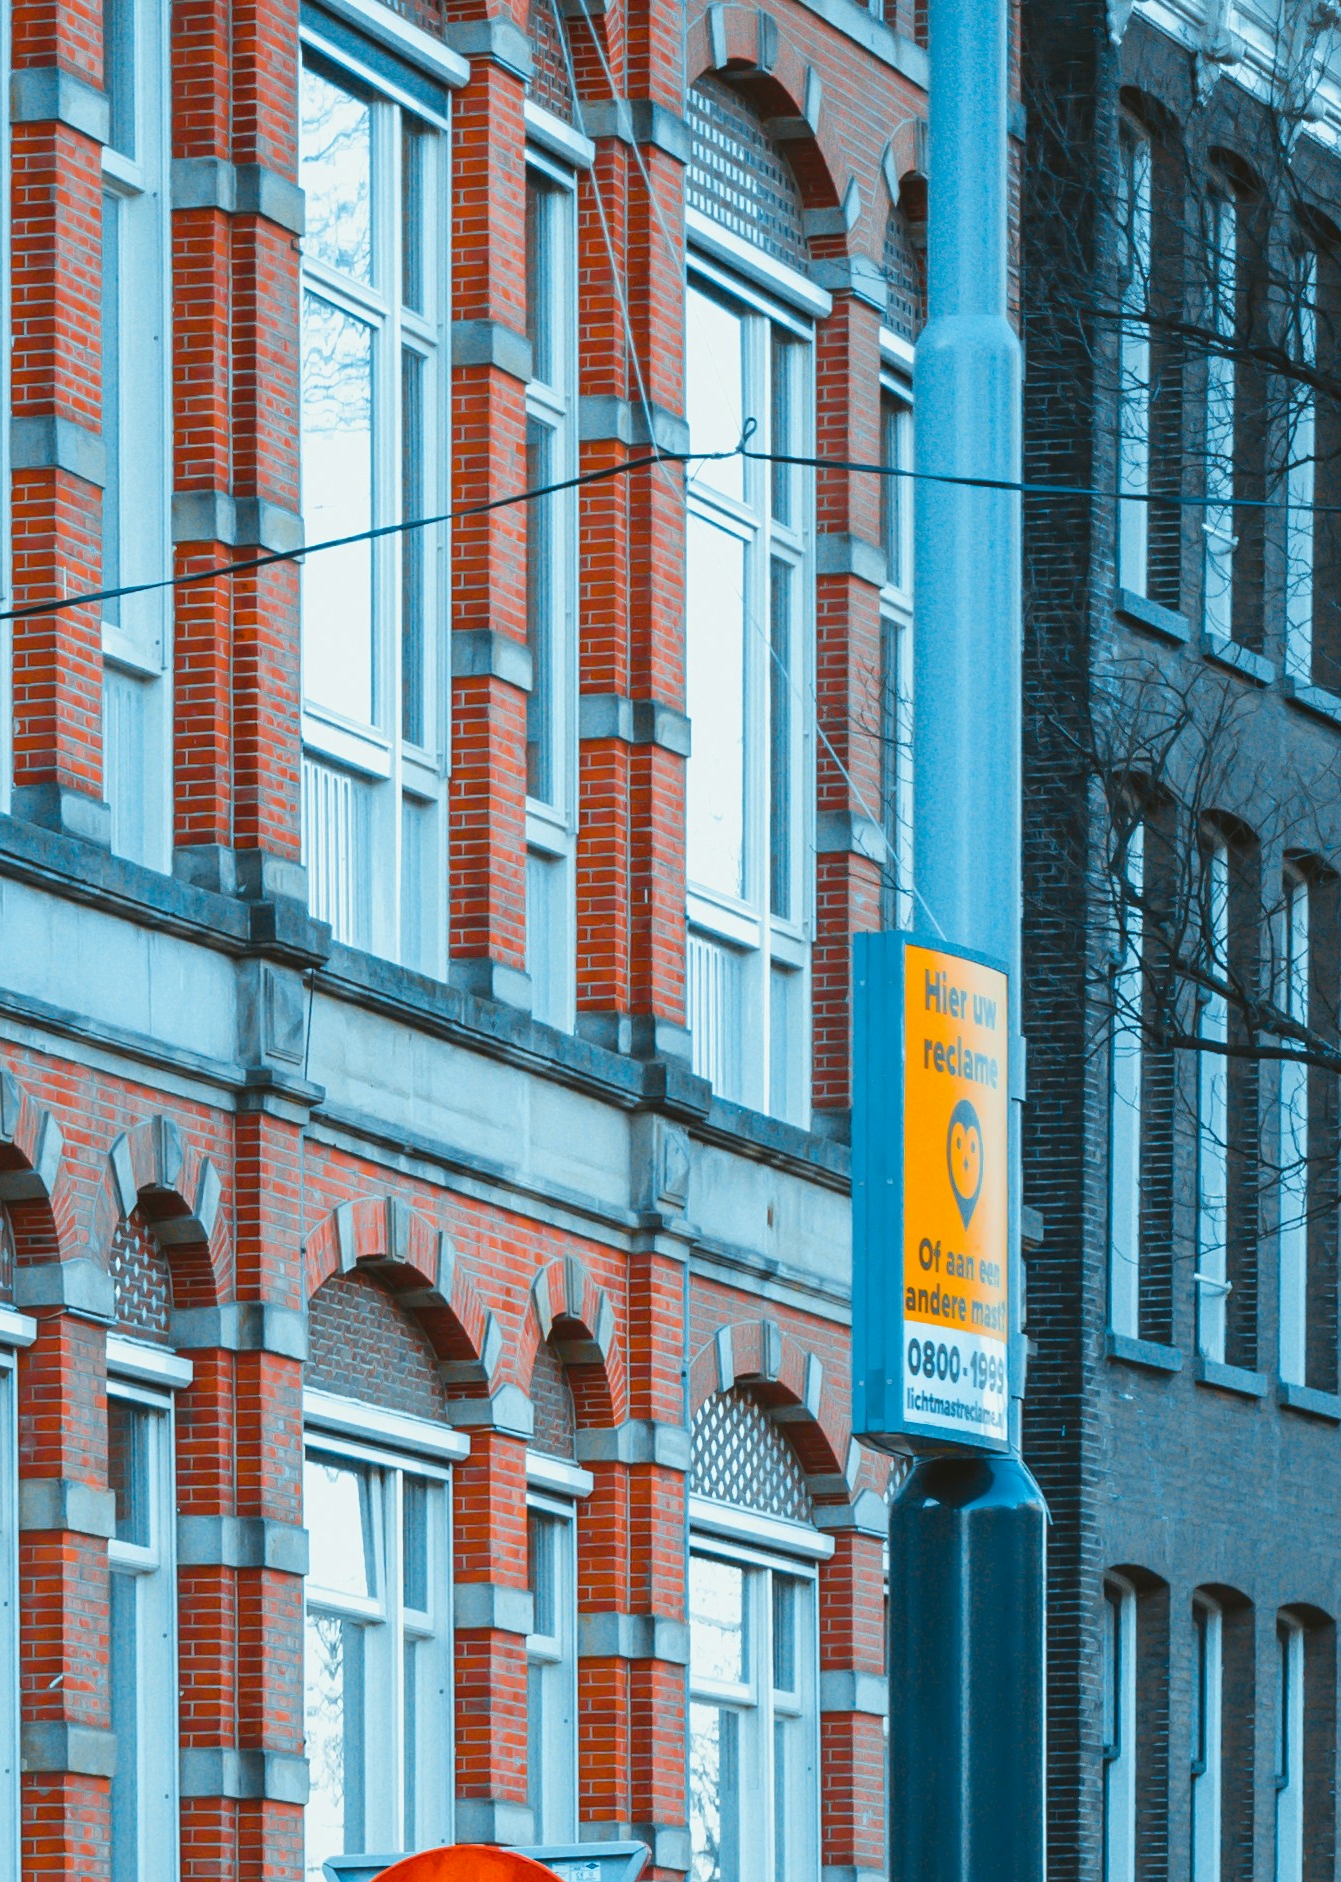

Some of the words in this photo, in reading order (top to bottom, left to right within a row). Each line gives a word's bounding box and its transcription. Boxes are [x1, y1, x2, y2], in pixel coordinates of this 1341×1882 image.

[924, 968, 967, 1020] Hier
[973, 994, 997, 1030] uw
[924, 1036, 999, 1090] reclame
[919, 1238, 941, 1273] Of
[946, 1251, 975, 1281] aan
[979, 1259, 1001, 1288] een
[905, 1283, 966, 1322] andere
